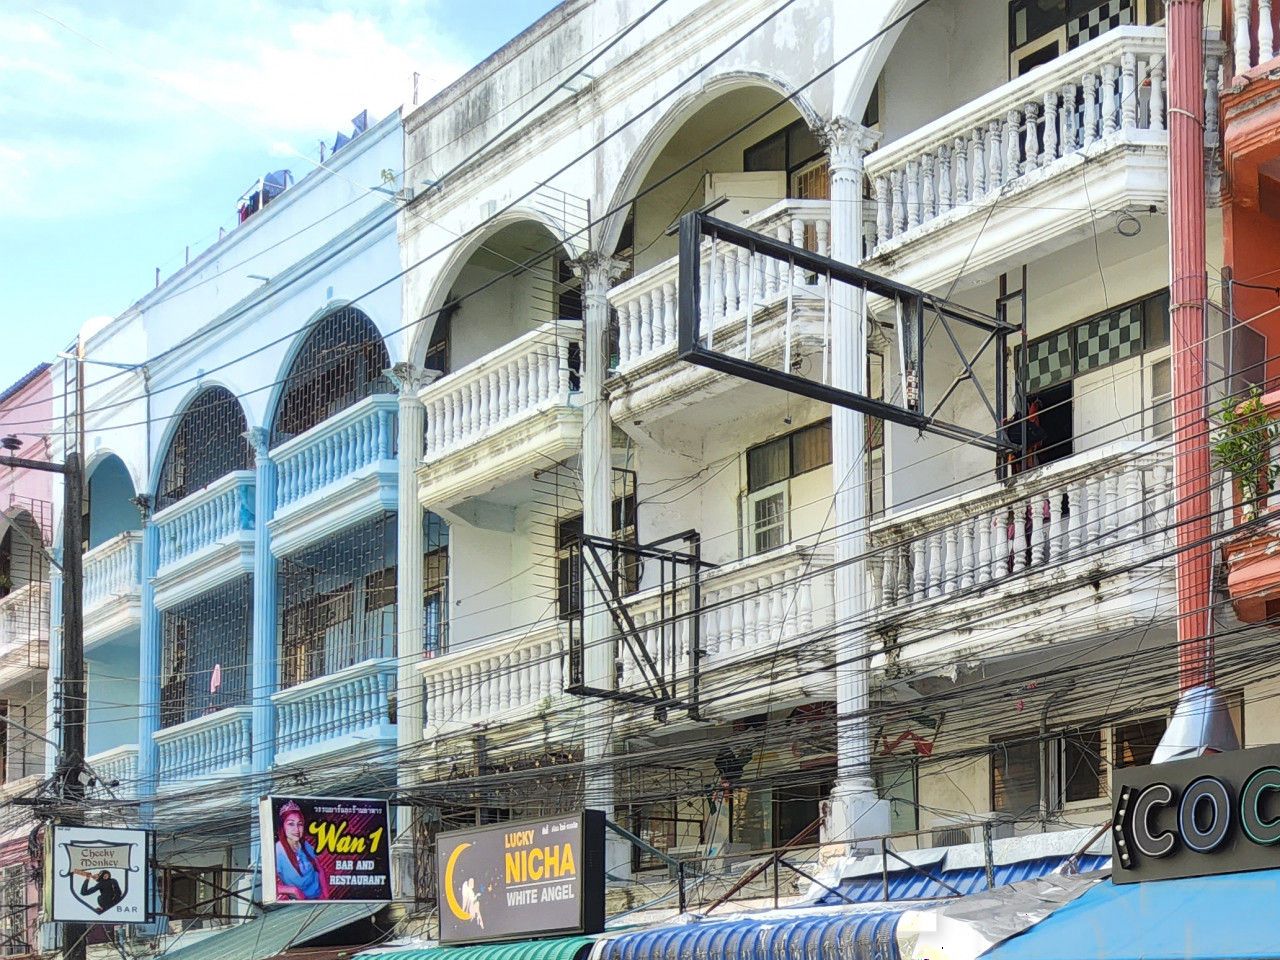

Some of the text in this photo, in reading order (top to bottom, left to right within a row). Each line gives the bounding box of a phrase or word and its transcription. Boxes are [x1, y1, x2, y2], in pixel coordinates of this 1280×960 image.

[309, 821, 365, 853] Wan
[505, 830, 534, 848] LUCKY
[81, 849, 115, 858] Cheeky
[80, 859, 118, 867] Monkey
[336, 861, 374, 870] BAR AND
[505, 843, 576, 883] NICHA
[330, 875, 386, 885] RESTAURANT
[507, 884, 575, 906] WHITE ANGEL
